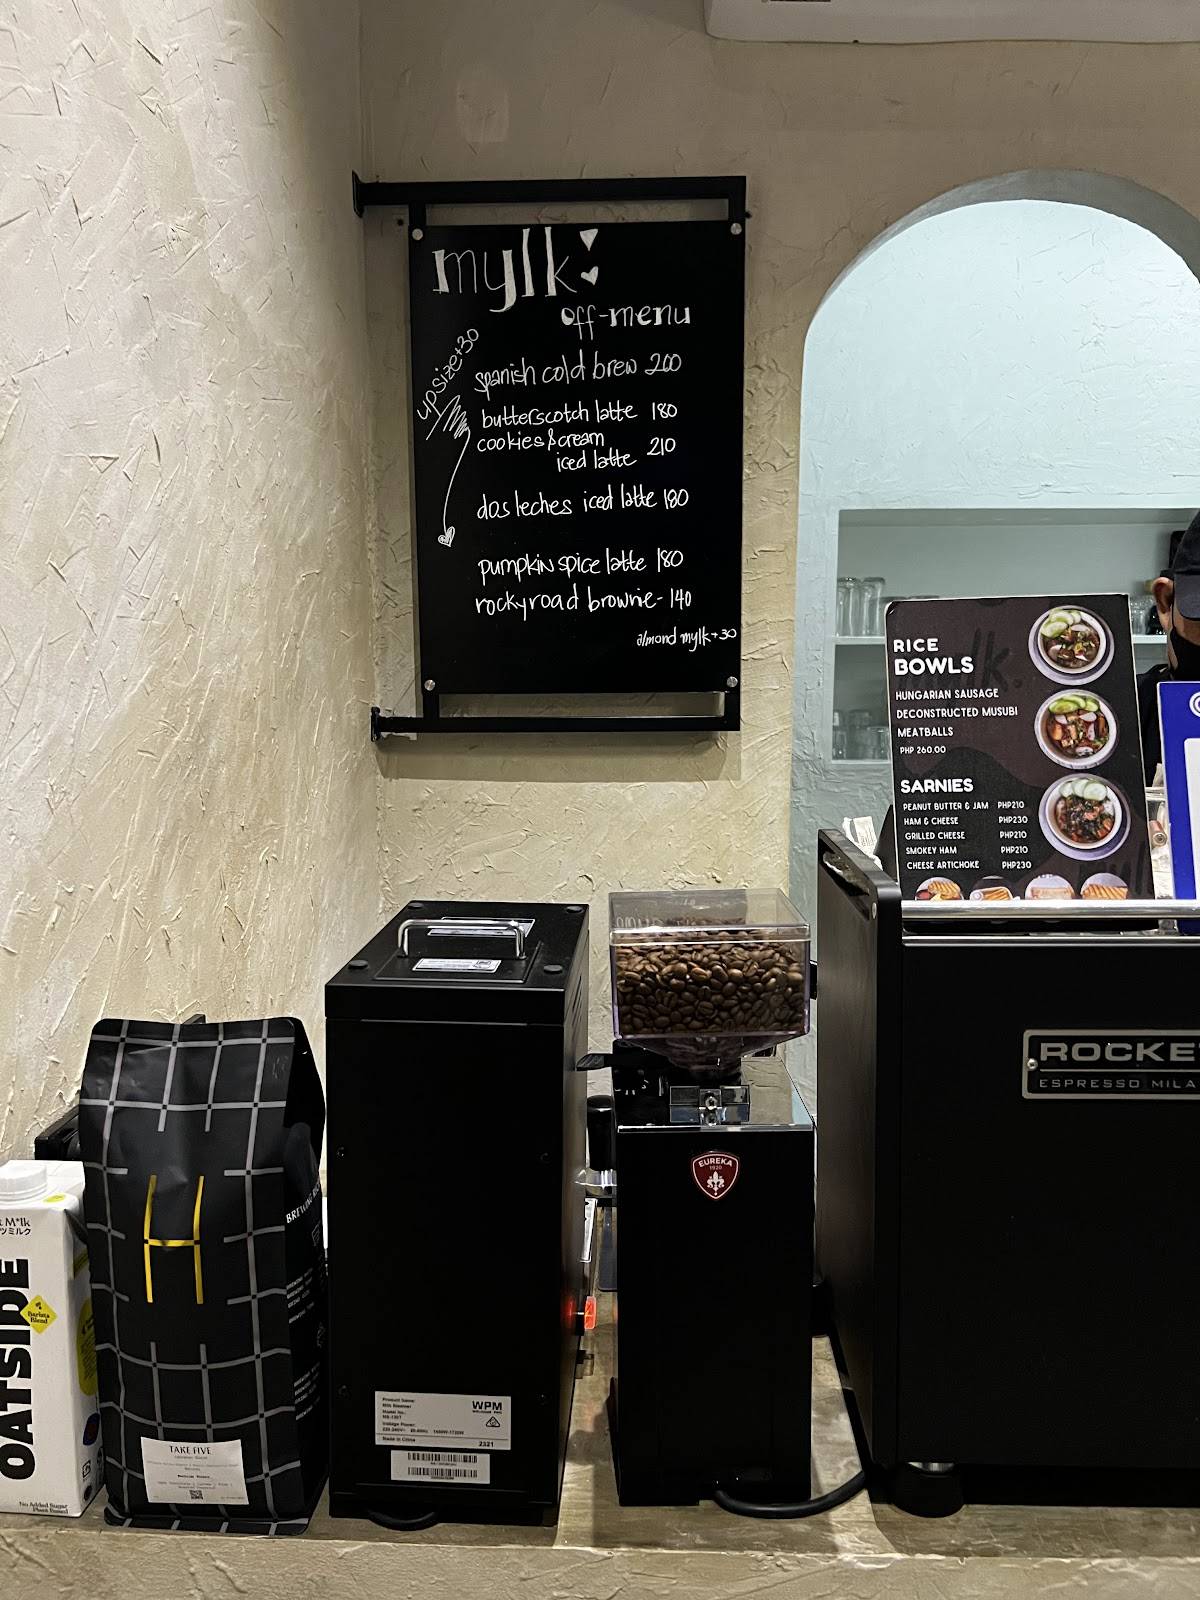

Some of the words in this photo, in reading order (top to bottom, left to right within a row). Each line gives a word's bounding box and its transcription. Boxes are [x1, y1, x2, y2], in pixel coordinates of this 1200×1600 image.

[432, 227, 577, 313] mylk
[562, 305, 690, 339] off-menu
[475, 358, 536, 400] spanish
[542, 349, 585, 384] cold
[593, 351, 636, 379] brew
[645, 353, 681, 375] 200
[482, 401, 589, 428] butterscotch
[596, 400, 637, 422] latte
[653, 403, 677, 420] 180
[647, 437, 675, 455] 210
[557, 451, 586, 472] iced
[594, 449, 637, 469] latte
[477, 494, 510, 519] dos
[515, 490, 572, 516] leches
[584, 484, 613, 512] iced
[621, 483, 657, 508] latte
[664, 489, 688, 509] 180
[558, 553, 600, 578] spice
[606, 548, 646, 574] latte
[658, 548, 683, 572] 180
[671, 588, 691, 610] 140
[637, 626, 676, 646] almond
[893, 637, 939, 653] RICE
[894, 656, 974, 676] BOWLS
[895, 689, 952, 701] HUNGARIAN
[954, 687, 1000, 699] SAUSAGE
[896, 707, 979, 720] DECONSTRUCTED
[981, 706, 1018, 717] MUSUBI
[897, 726, 954, 738] MEATBALLS
[899, 746, 915, 755] PHP
[916, 745, 947, 754] 260.00
[900, 777, 974, 794] SARNIES
[902, 802, 932, 812] PEANUT
[933, 801, 963, 811] BUTTER
[972, 801, 989, 810] JAM
[997, 800, 1025, 809] PHP210
[903, 817, 922, 826] HAM
[932, 816, 959, 825] CHEESE
[998, 815, 1029, 824] PHP230
[904, 831, 936, 841] GRILLED
[937, 831, 966, 840] CHEESE
[999, 830, 1027, 839] PHP210
[905, 846, 937, 855] SMOKEY
[939, 846, 958, 855] HAM
[1000, 845, 1029, 854] PHP210
[906, 861, 935, 870] CHEESE
[936, 860, 980, 869] ARTICHOKE
[1001, 860, 1032, 870] PHP230
[1040, 1042, 1200, 1062] ROCKE
[1038, 1079, 1140, 1089] ESPRESSO
[698, 1157, 733, 1168] EUREKA
[0, 1259, 36, 1480] OATSIDE
[472, 1400, 503, 1411] WPM
[169, 1445, 191, 1454] TAKE
[193, 1446, 212, 1455] FIVE
[479, 1440, 494, 1448] 2321
